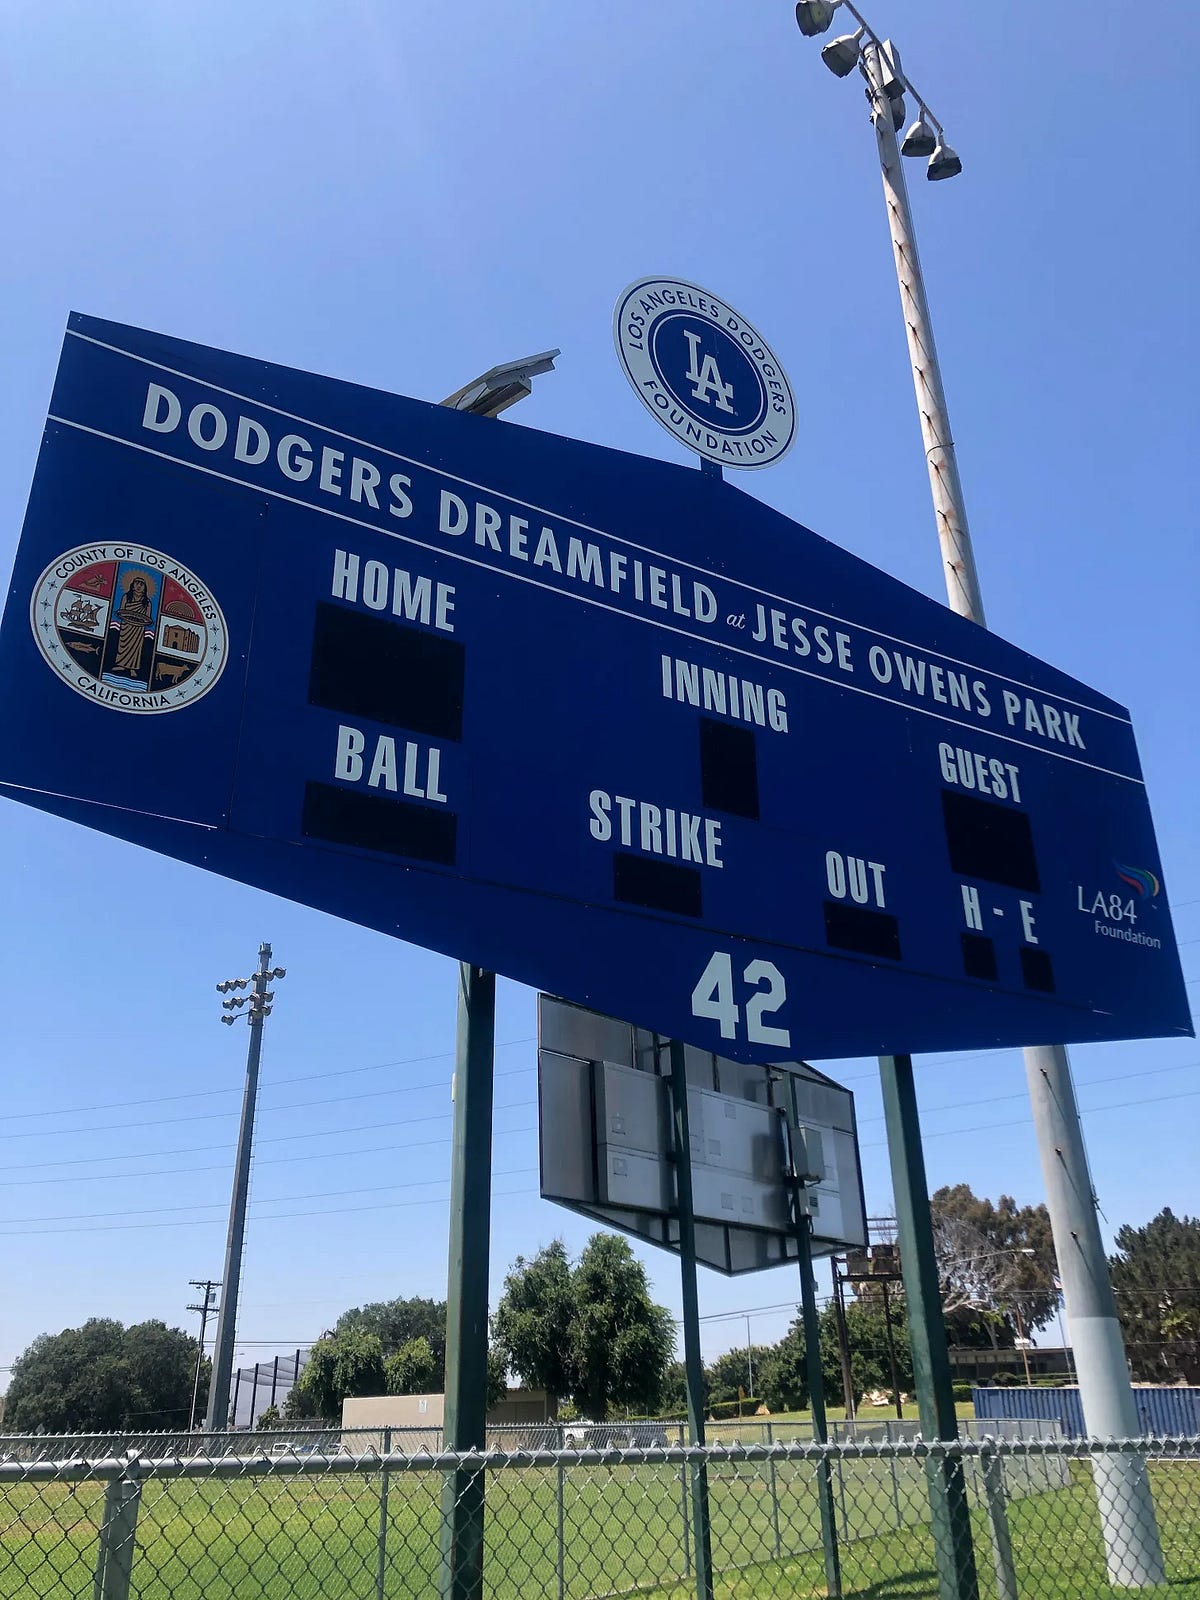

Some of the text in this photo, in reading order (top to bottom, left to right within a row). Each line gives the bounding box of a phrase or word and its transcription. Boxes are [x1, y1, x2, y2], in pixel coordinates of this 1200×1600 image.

[628, 289, 786, 415] LOS ANGELES DODGERS
[683, 329, 734, 414] LA
[644, 380, 778, 456] FOUNDATION
[55, 548, 216, 620] COUNTY OF LOS ANGELES
[143, 383, 1085, 749] DODGERS DREAMFIELD at JESSE OWENS PARK
[332, 549, 455, 632] HOME
[77, 676, 170, 707] CALIFORNIA
[662, 655, 788, 733] INNING
[335, 725, 446, 802] BALL
[939, 743, 1020, 802] GUEST
[589, 790, 723, 868] STRIKE
[826, 851, 886, 907] OUT
[961, 885, 982, 930] H
[1020, 901, 1038, 943] E
[1078, 886, 1137, 924] LA84
[1095, 920, 1160, 949] Foundation
[692, 952, 790, 1047] 42
